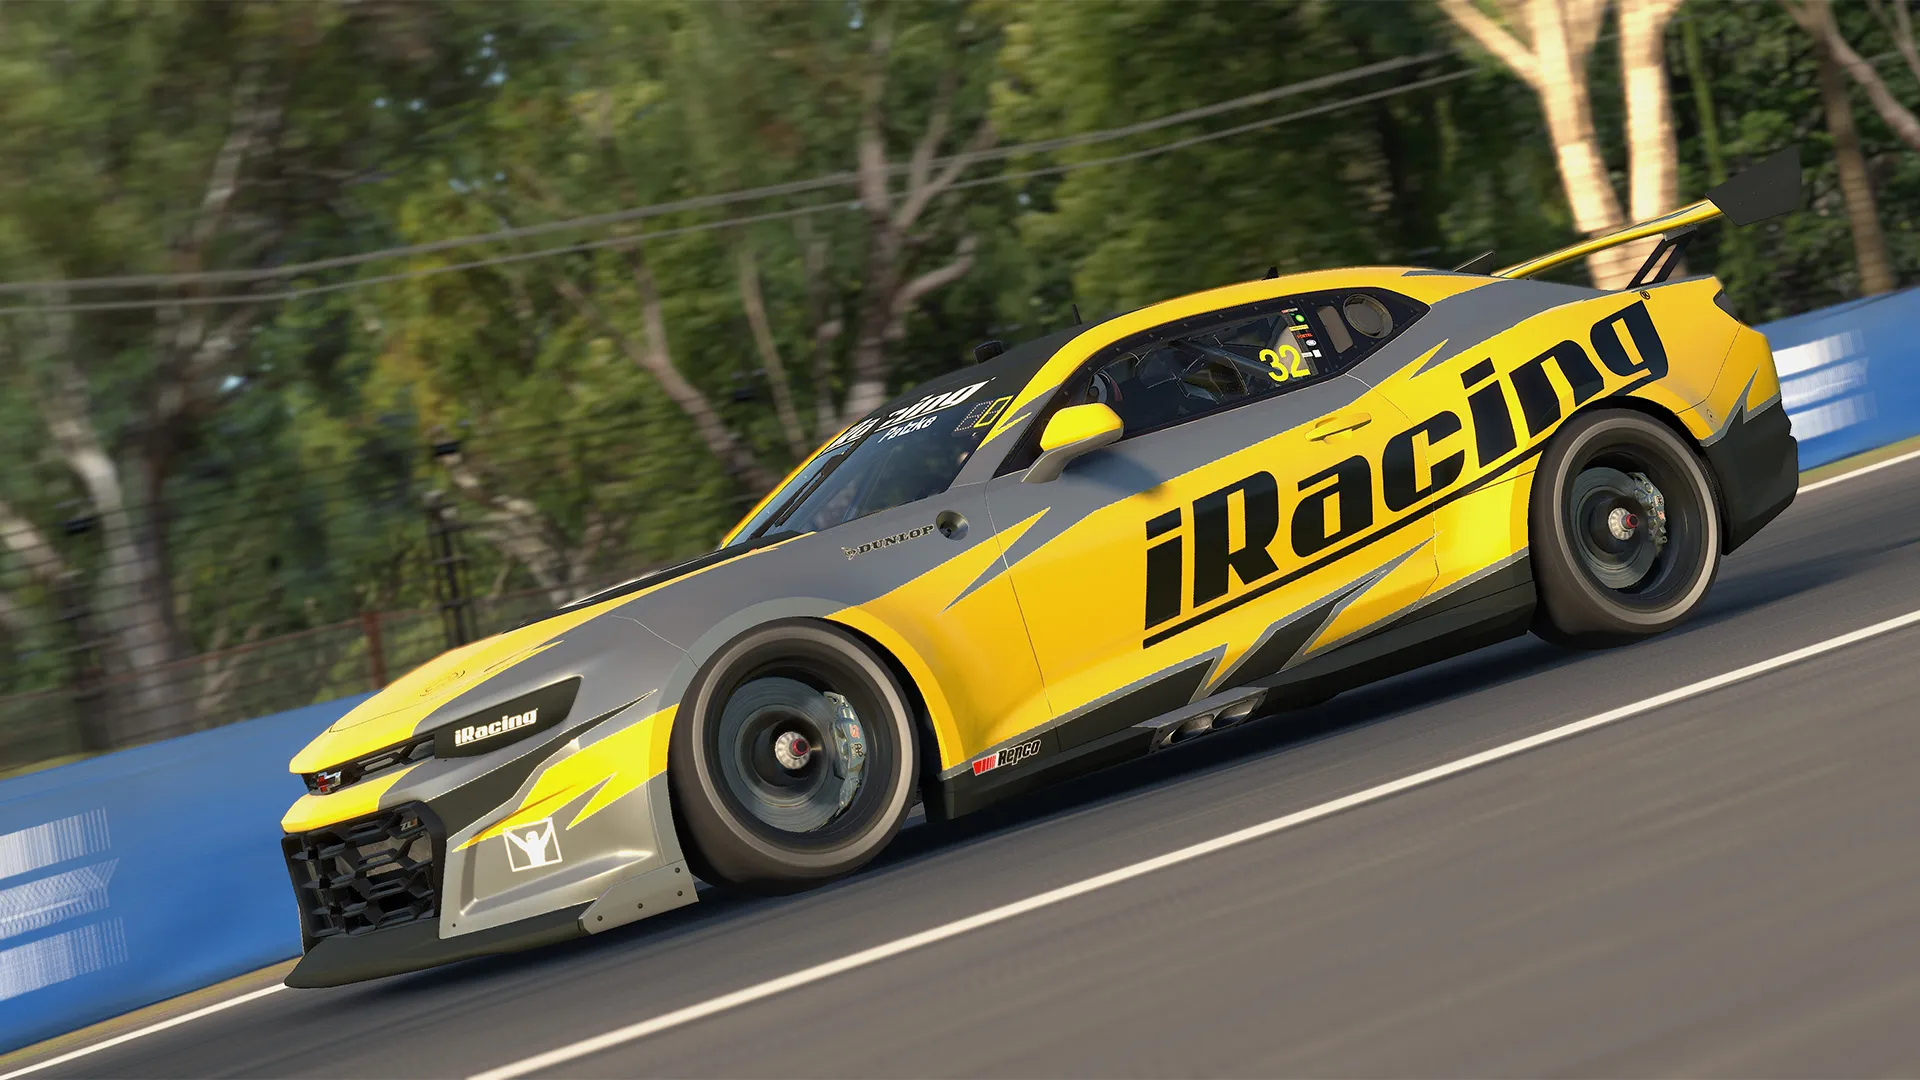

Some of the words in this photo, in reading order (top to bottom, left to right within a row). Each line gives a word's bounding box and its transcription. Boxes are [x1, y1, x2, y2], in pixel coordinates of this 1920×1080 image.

[1259, 344, 1311, 382] 32
[1142, 299, 1669, 649] iRacing
[858, 524, 934, 554] DUNLOP
[455, 708, 538, 747] iRacing
[997, 740, 1042, 765] Repco
